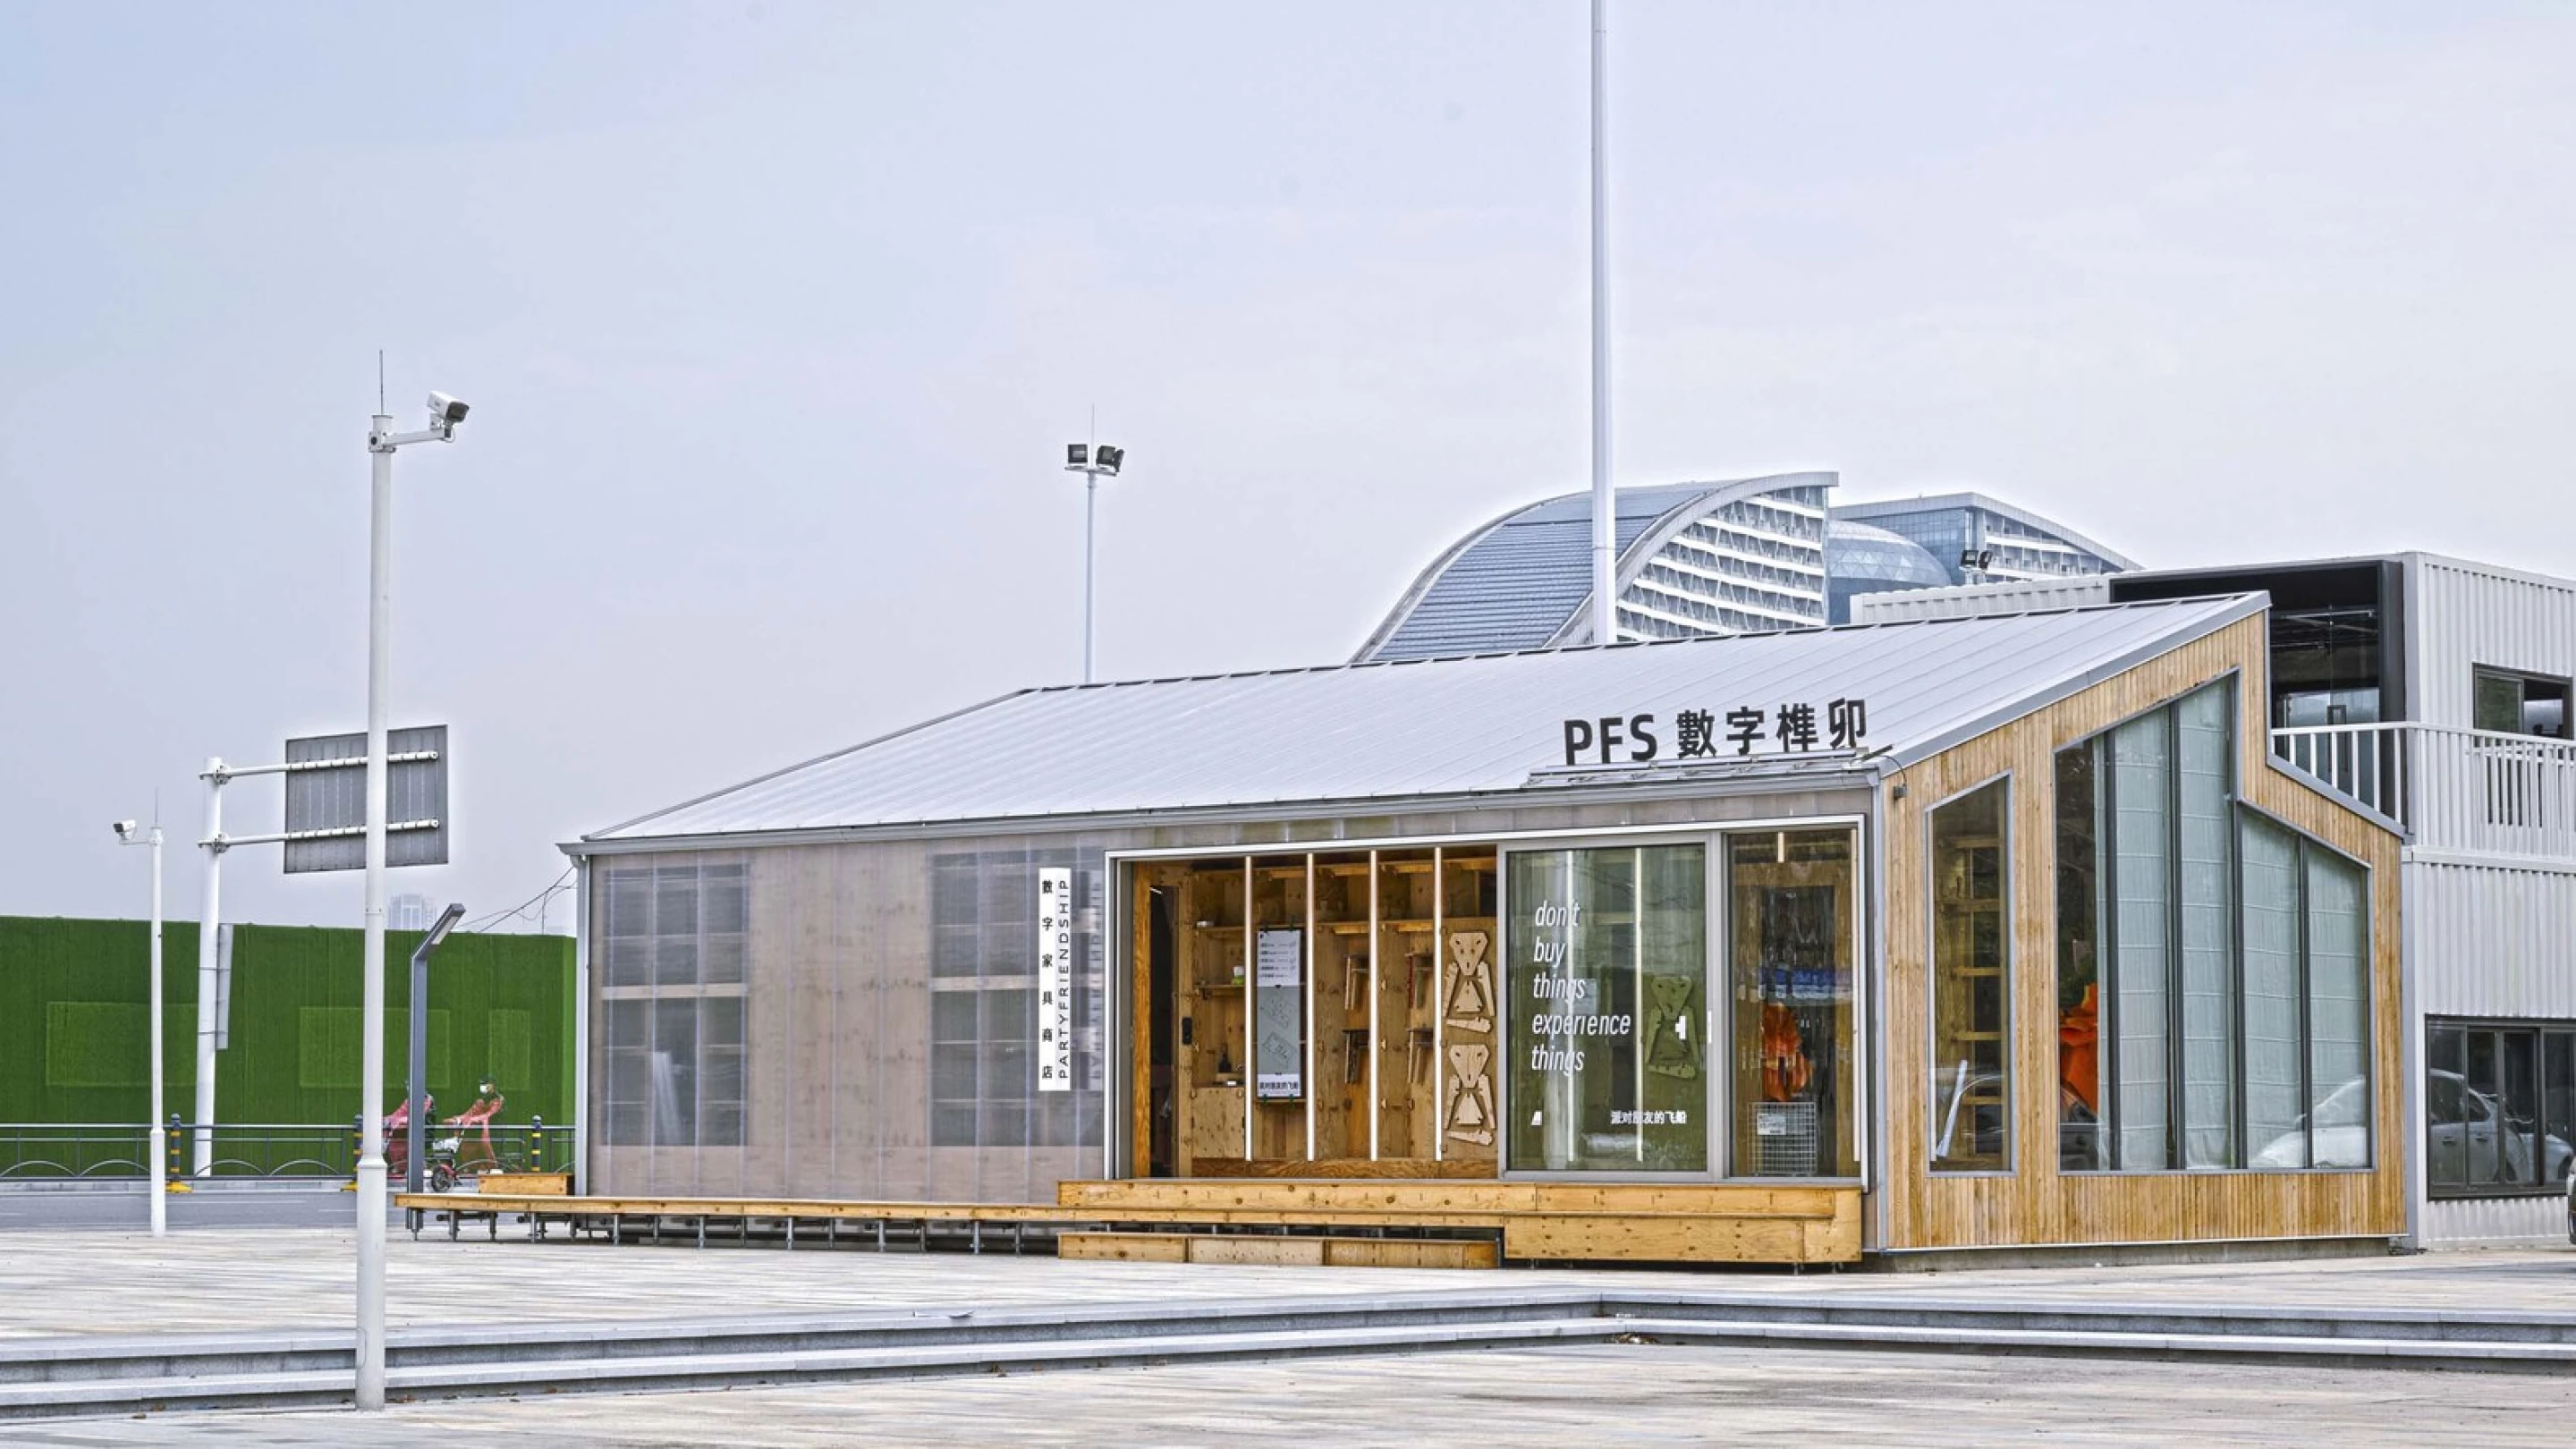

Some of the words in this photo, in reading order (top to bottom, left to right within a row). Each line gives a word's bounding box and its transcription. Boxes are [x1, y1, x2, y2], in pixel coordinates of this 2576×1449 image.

[1563, 714, 1658, 766] PFS
[1675, 697, 1867, 759] 數字榫卯
[1533, 936, 1565, 969] buy
[1057, 879, 1070, 1080] PARTYFRIENDSHIP
[1533, 971, 1586, 1004] things
[1532, 1013, 1631, 1040] experience
[1531, 1043, 1585, 1076] things
